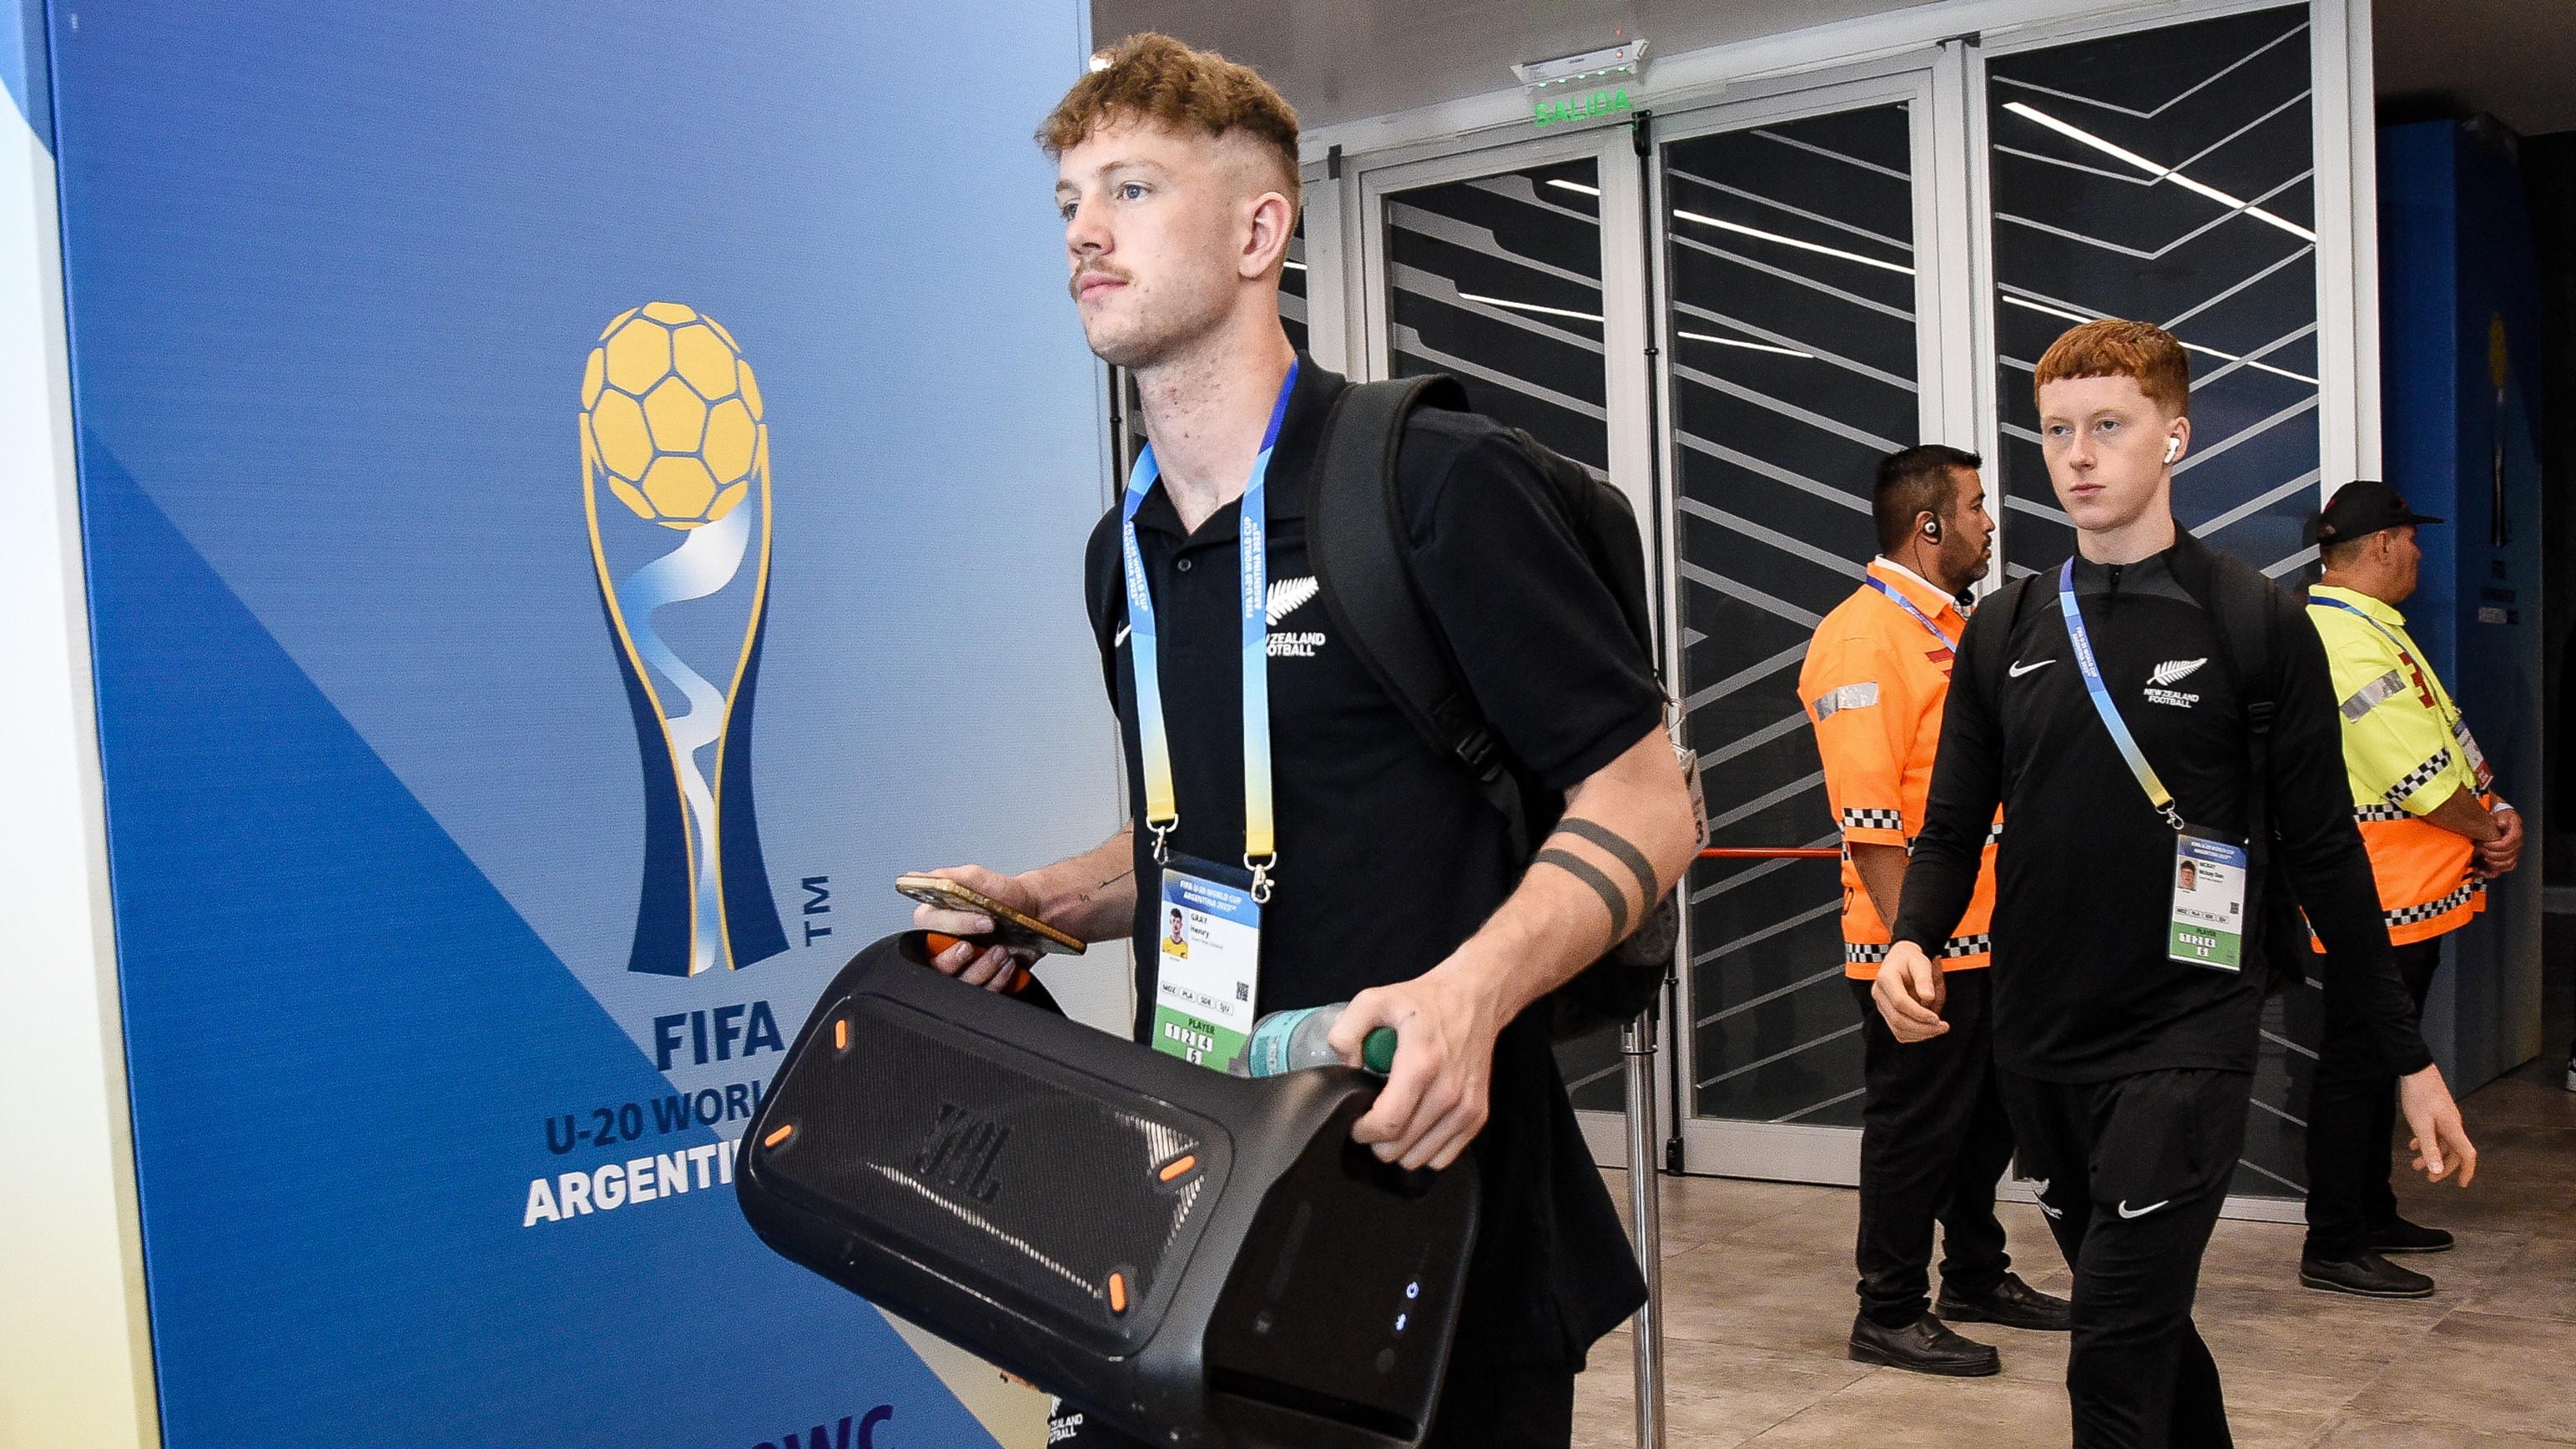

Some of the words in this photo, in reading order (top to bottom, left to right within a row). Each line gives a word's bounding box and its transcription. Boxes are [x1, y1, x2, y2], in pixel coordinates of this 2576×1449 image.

[1534, 88, 1632, 128] SALIDA
[1243, 516, 1252, 537] CUP
[1243, 537, 1253, 573] WORLD
[1133, 557, 1144, 592] WORLD
[1253, 553, 1262, 609] ARGENTINA
[1138, 592, 1148, 611] CUP
[1267, 644, 1316, 657] OTBALL
[2148, 695, 2192, 708] FOOTBALL
[802, 875, 831, 947] TM
[653, 1000, 785, 1073] FIFA
[1187, 1017, 1216, 1034] PLAYER
[547, 1103, 643, 1155] U-20
[652, 1079, 762, 1135] WORL
[915, 1103, 1011, 1204] JBL
[522, 1138, 742, 1228] ARGENTI
